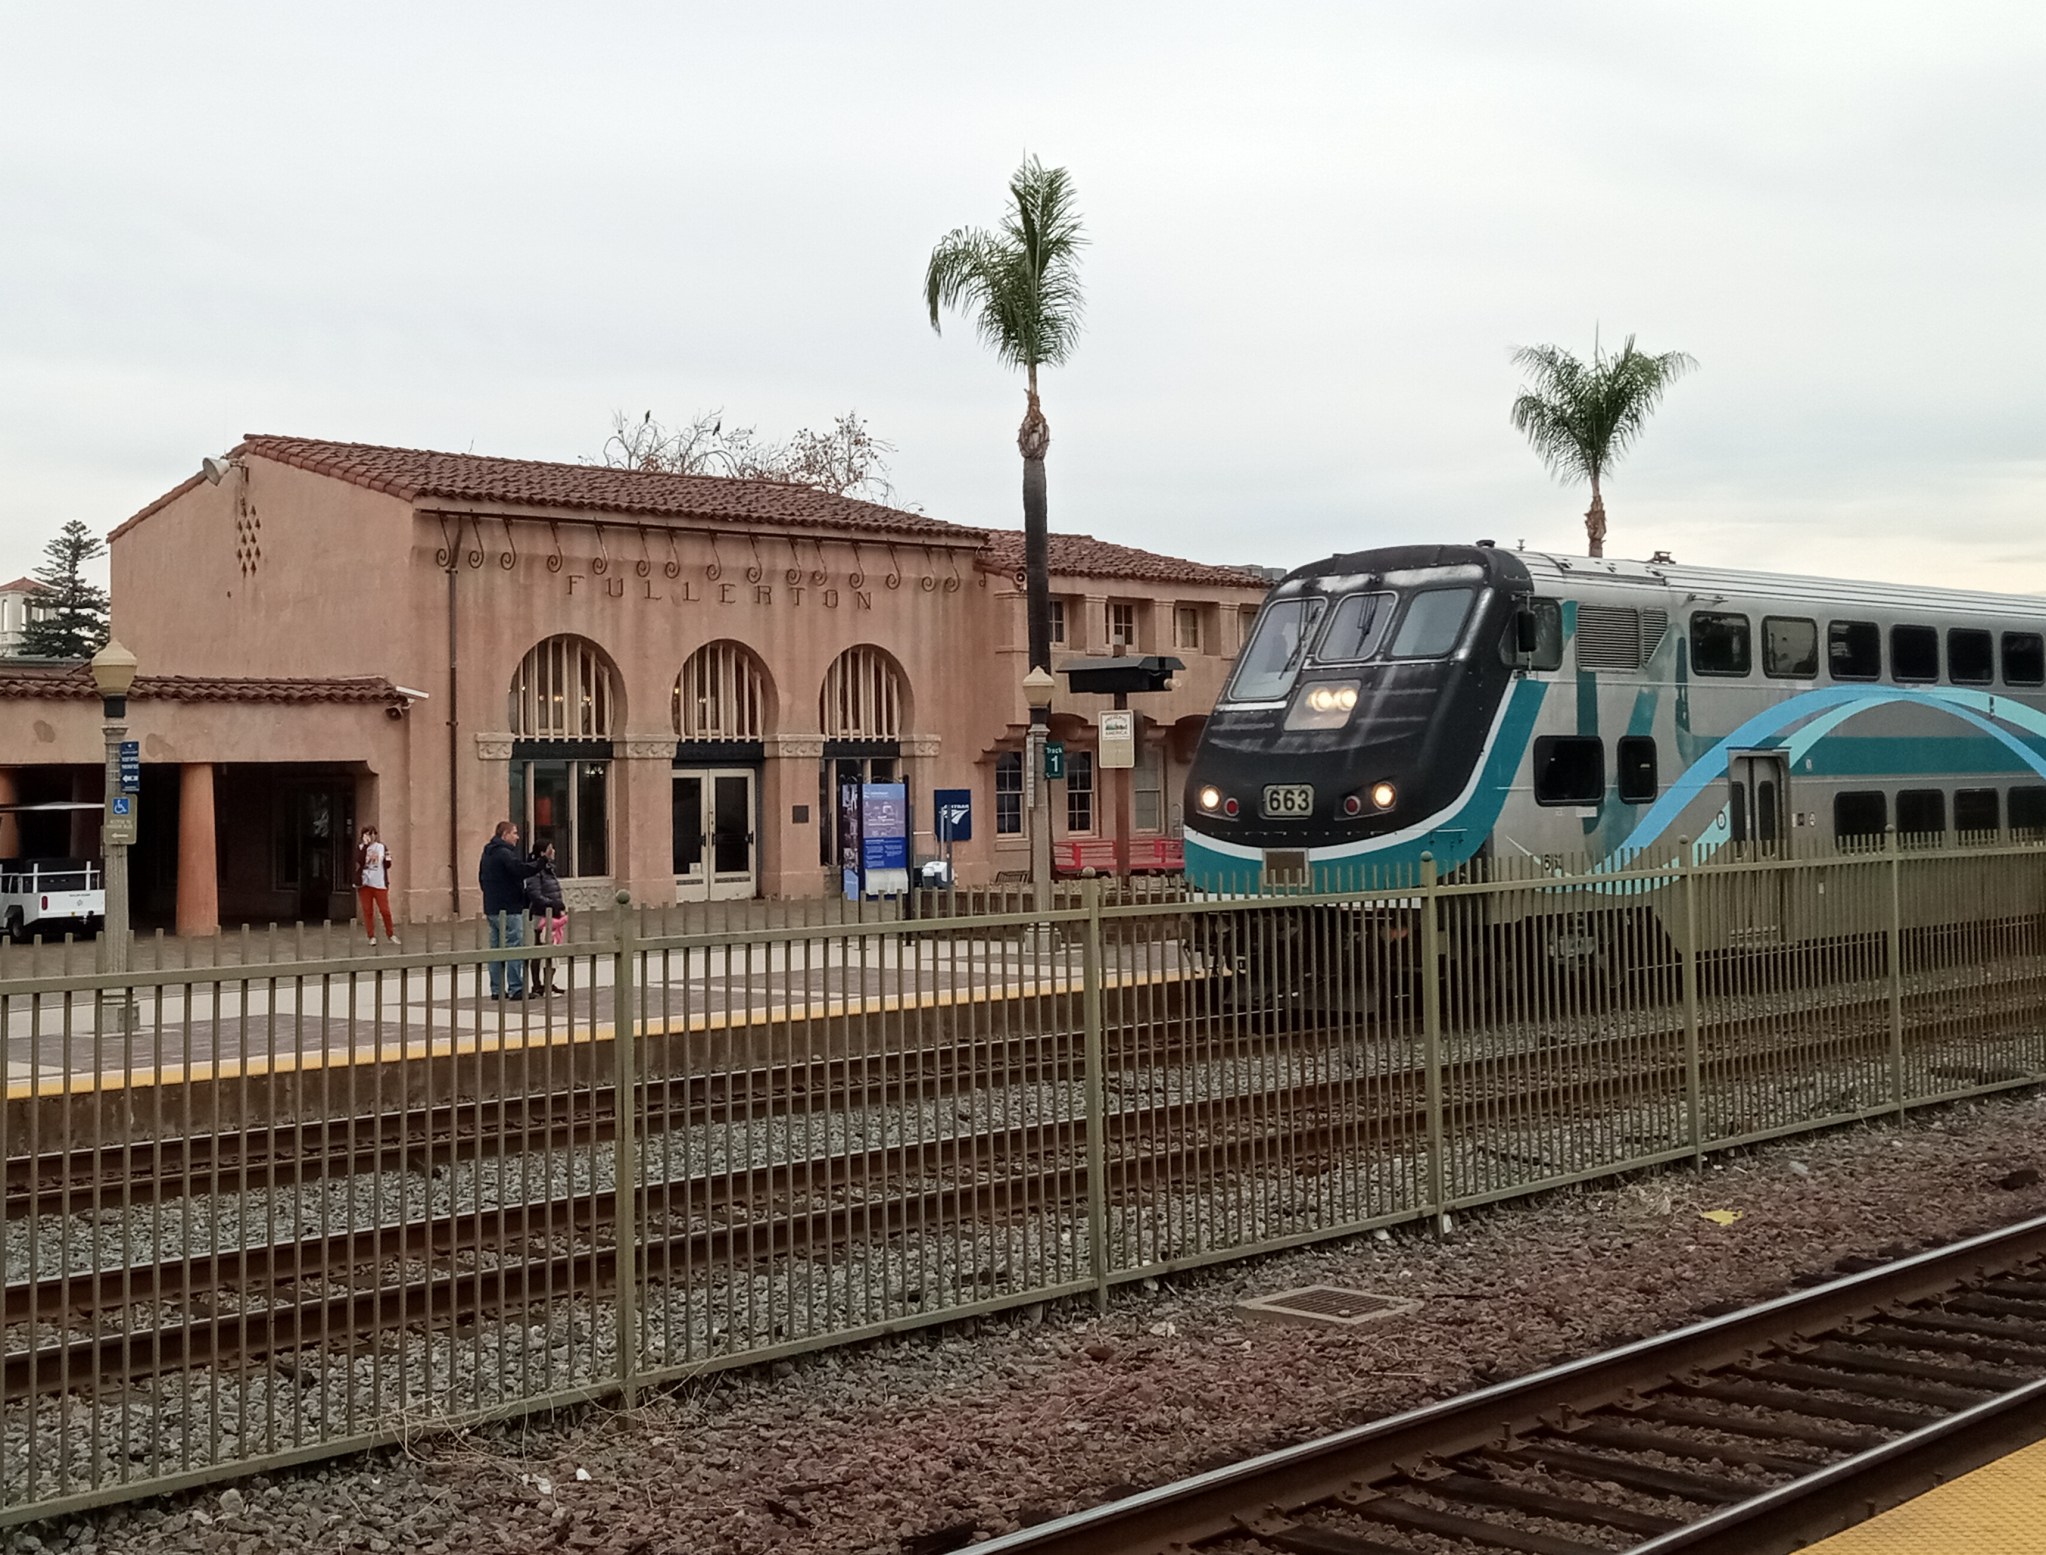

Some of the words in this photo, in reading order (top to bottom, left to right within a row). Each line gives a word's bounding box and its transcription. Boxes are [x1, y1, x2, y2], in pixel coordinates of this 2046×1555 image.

[566, 575, 872, 610] FULLERTON
[1051, 755, 1058, 772] 1
[1269, 789, 1310, 811] 663
